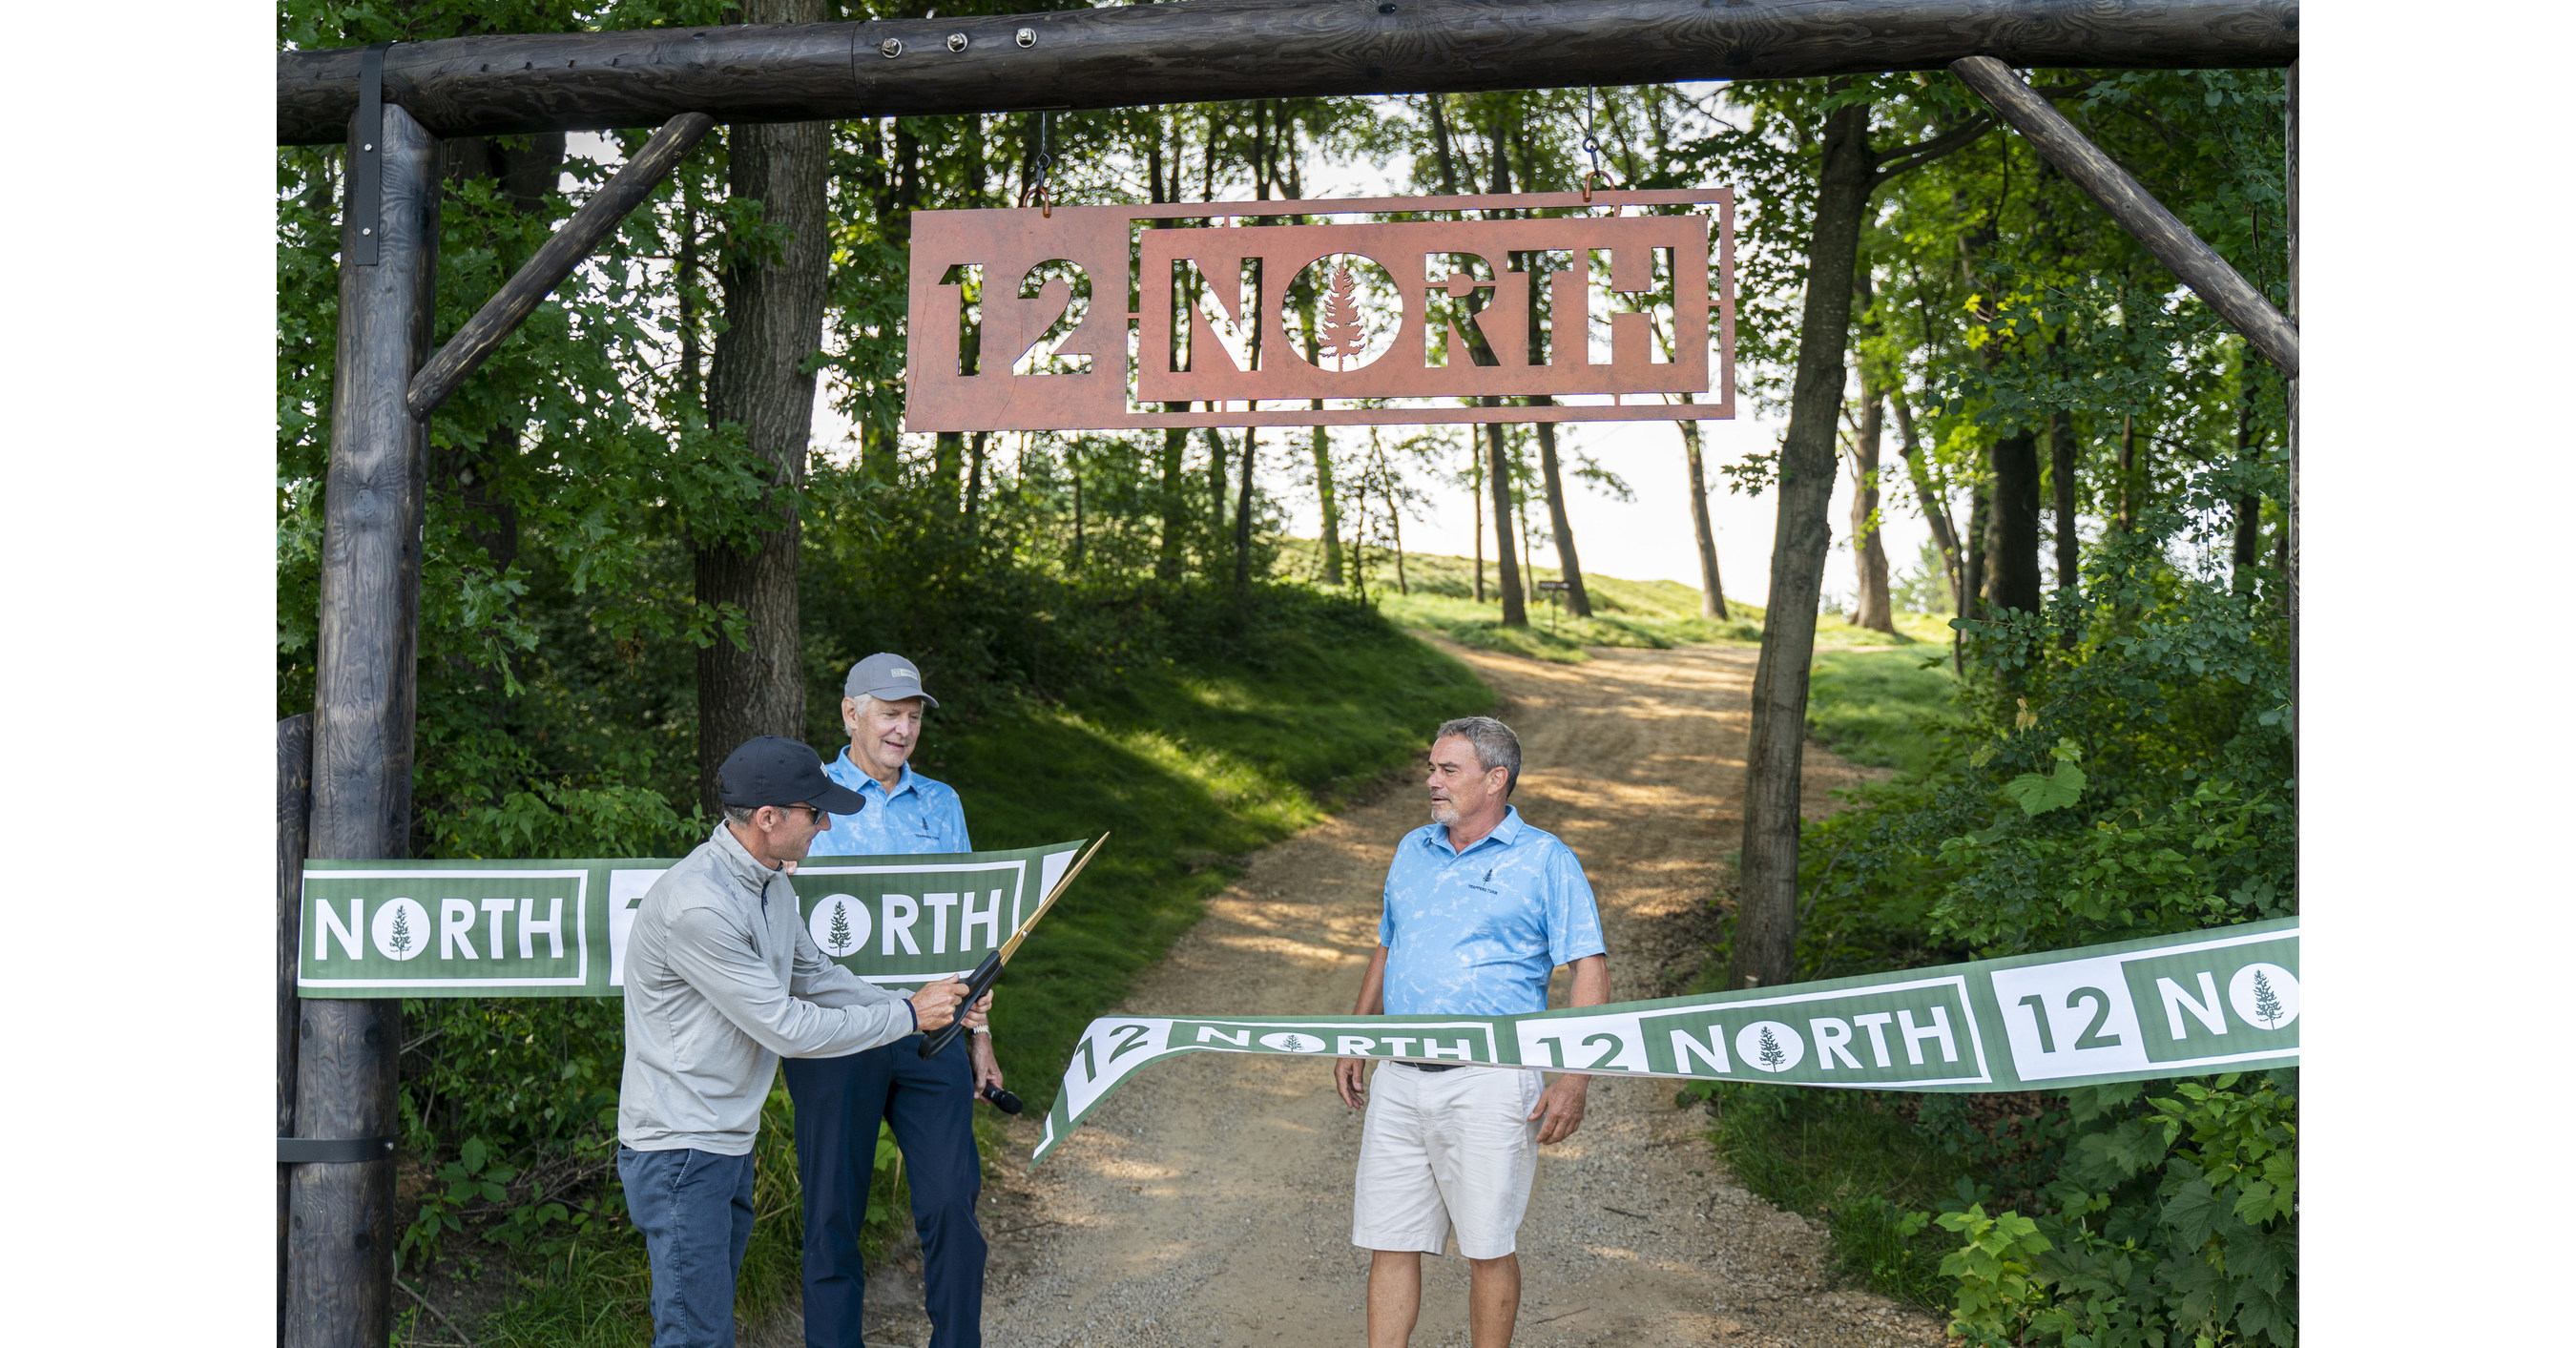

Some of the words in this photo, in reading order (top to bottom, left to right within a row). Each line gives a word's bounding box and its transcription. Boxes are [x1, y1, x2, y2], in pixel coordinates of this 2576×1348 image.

[938, 258, 1092, 377] 12
[1170, 245, 1677, 373] NORTH
[314, 897, 564, 962] NORTH
[796, 888, 1003, 958] ORTH
[1075, 1024, 1151, 1084] 12
[1195, 1026, 1472, 1061] NORTH
[1536, 1032, 1630, 1071] 12
[1670, 1006, 1958, 1074] NORTH
[2018, 985, 2122, 1055] 12
